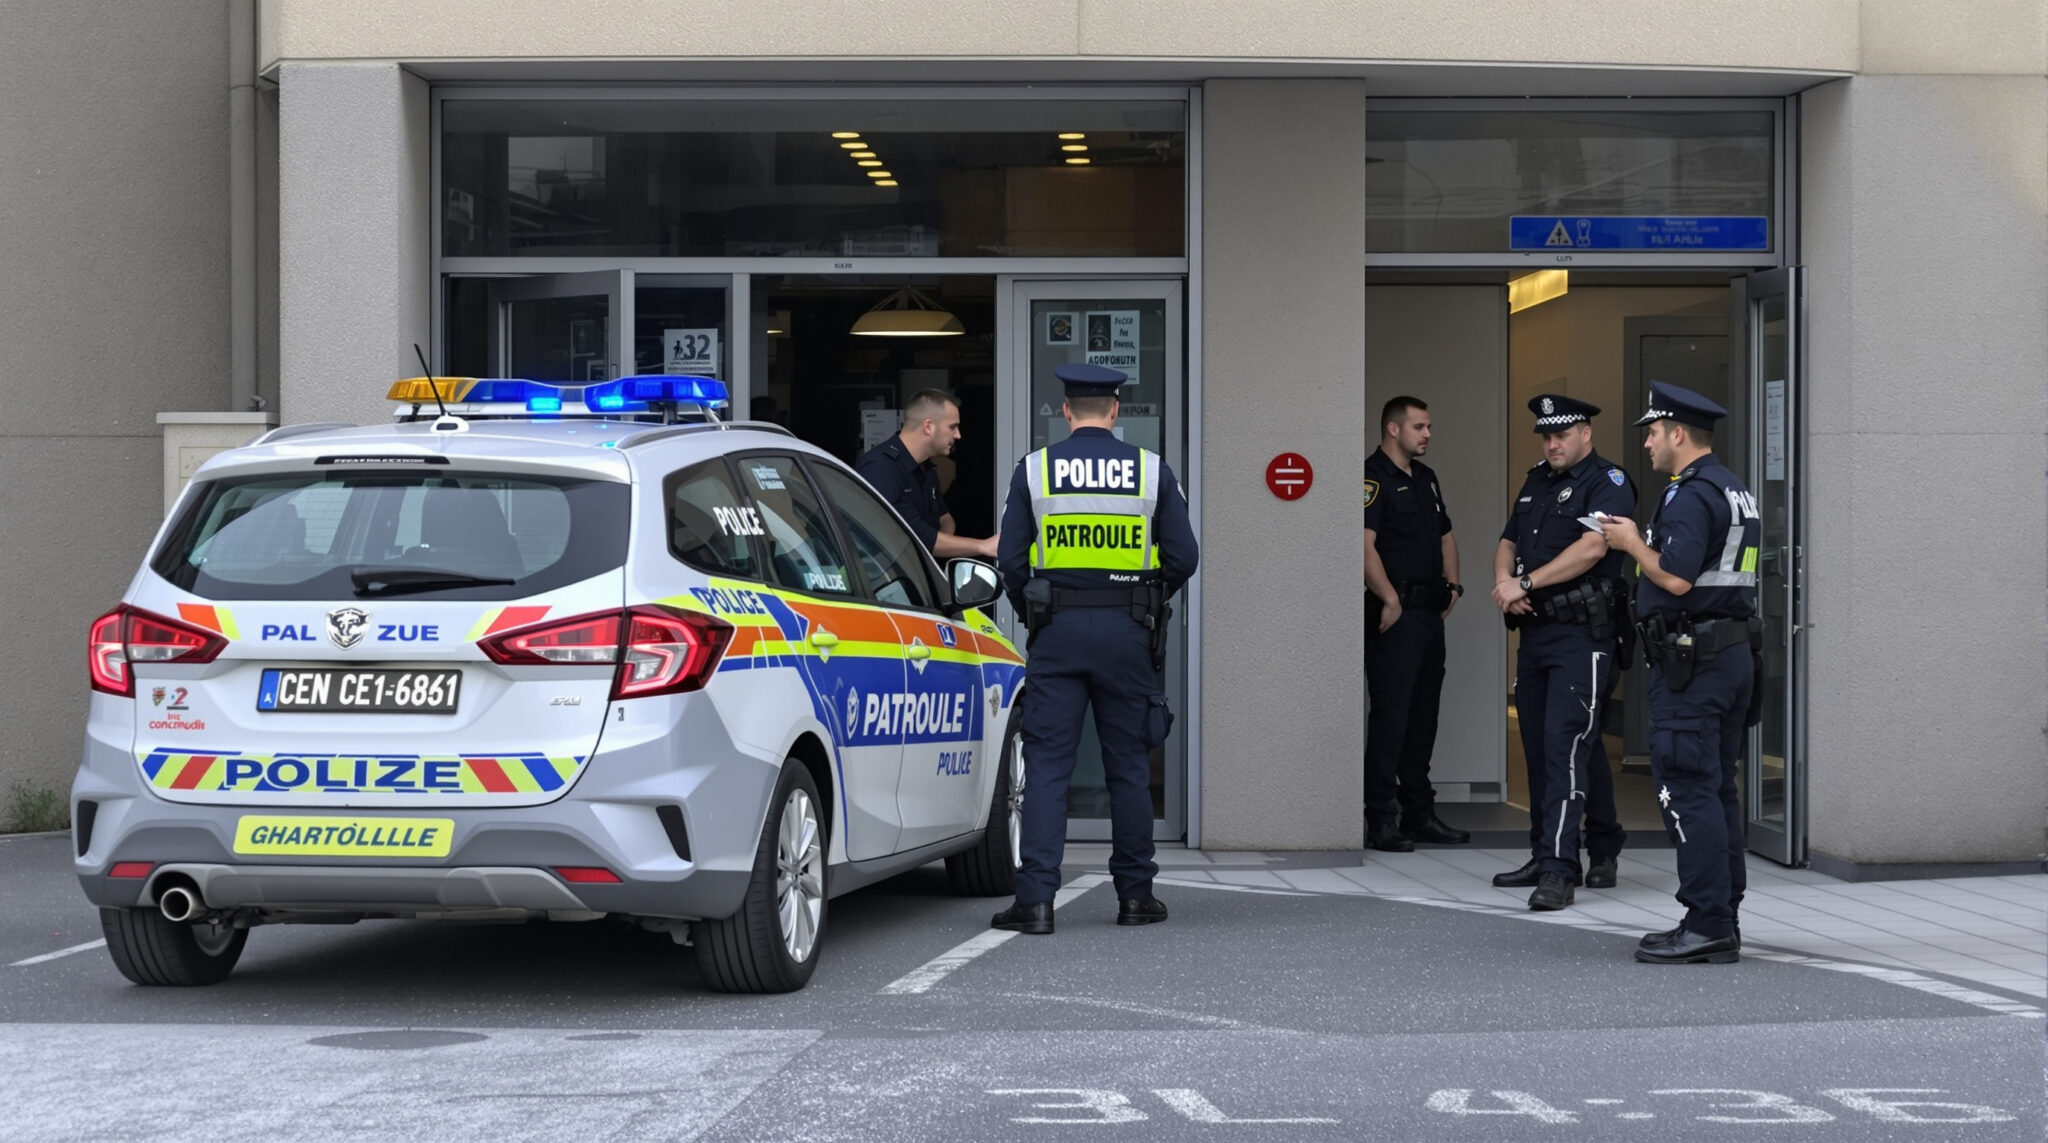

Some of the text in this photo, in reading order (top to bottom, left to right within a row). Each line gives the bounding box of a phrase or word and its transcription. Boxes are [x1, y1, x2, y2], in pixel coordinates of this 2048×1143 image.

[684, 334, 711, 360] 32
[1054, 458, 1135, 489] POLICE
[713, 506, 765, 536] POLICE
[1046, 524, 1143, 550] PATROULE
[703, 587, 767, 616] POLICE
[261, 624, 317, 642] PAL
[377, 624, 440, 642] ZUE
[280, 673, 332, 705] CEN
[863, 693, 966, 737] PATROULE
[226, 758, 461, 788] POLIZE
